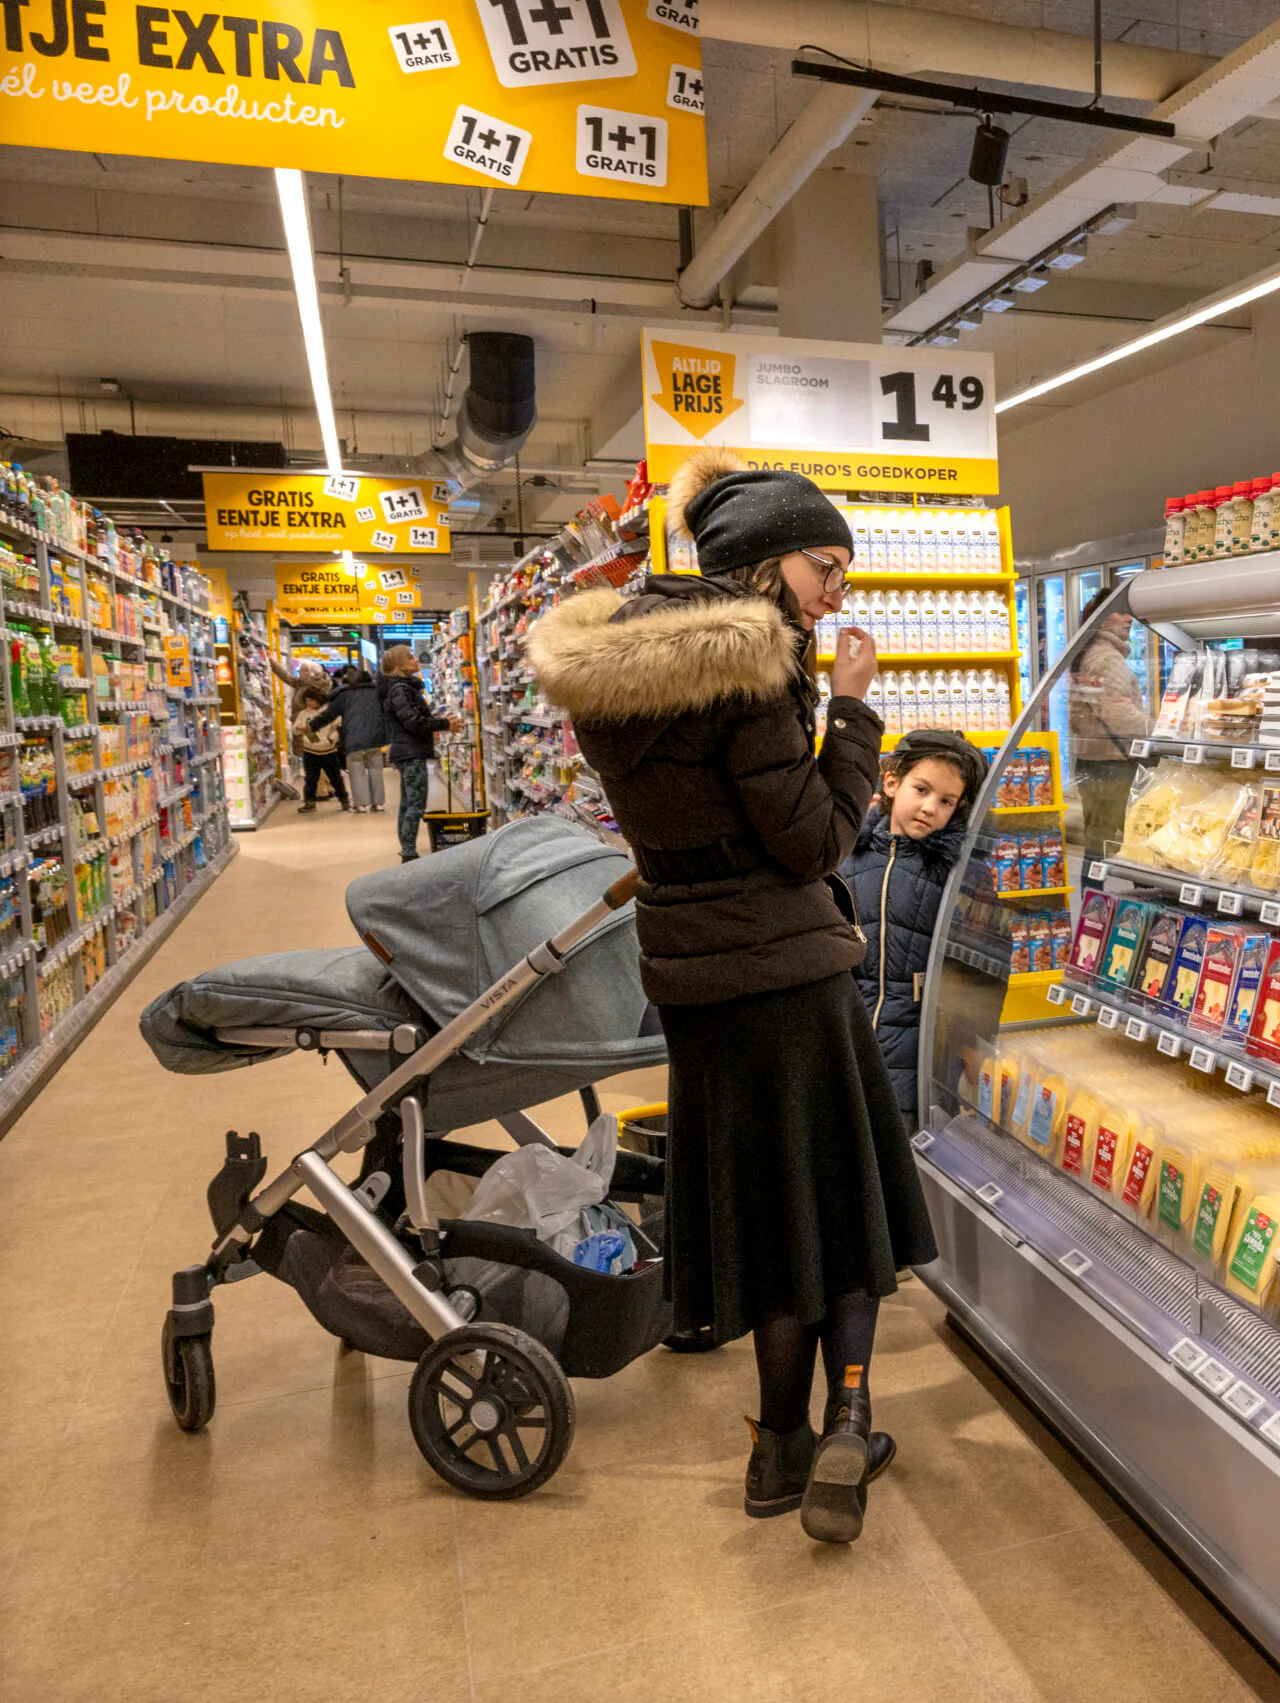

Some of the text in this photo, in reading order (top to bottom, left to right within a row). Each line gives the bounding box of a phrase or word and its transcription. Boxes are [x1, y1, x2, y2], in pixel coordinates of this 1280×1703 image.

[488, 0, 611, 46] 1+1
[136, 5, 356, 88] EXTRA
[395, 27, 449, 55] 1+1
[405, 52, 452, 68] GRATIS
[509, 44, 619, 73] GRATIS
[52, 73, 139, 108] veel
[146, 84, 345, 128] producten
[462, 115, 521, 163] 1+1
[586, 117, 657, 161] 1+1
[453, 145, 512, 176] GRATIS
[586, 155, 656, 178] GRATIS
[672, 357, 721, 374] ALTIJD
[756, 362, 802, 374] JUMBO
[672, 373, 722, 395] LAGE
[756, 375, 829, 389] SLAGROOM
[673, 394, 724, 414] PRIJS
[790, 462, 852, 478] EURO'S
[857, 464, 958, 481] GOEDKOPER
[248, 490, 313, 508] GRATIS
[383, 491, 421, 512] 1+1
[217, 509, 346, 528] EENTJE EXTRA
[389, 508, 423, 521] GRATIS
[375, 533, 394, 546] 1+1
[411, 529, 435, 541] 1+1
[301, 572, 340, 583] GRATIS
[381, 571, 404, 583] 1+1
[283, 584, 359, 594] EENTJE EXTRA
[480, 979, 517, 1009] VISTA
